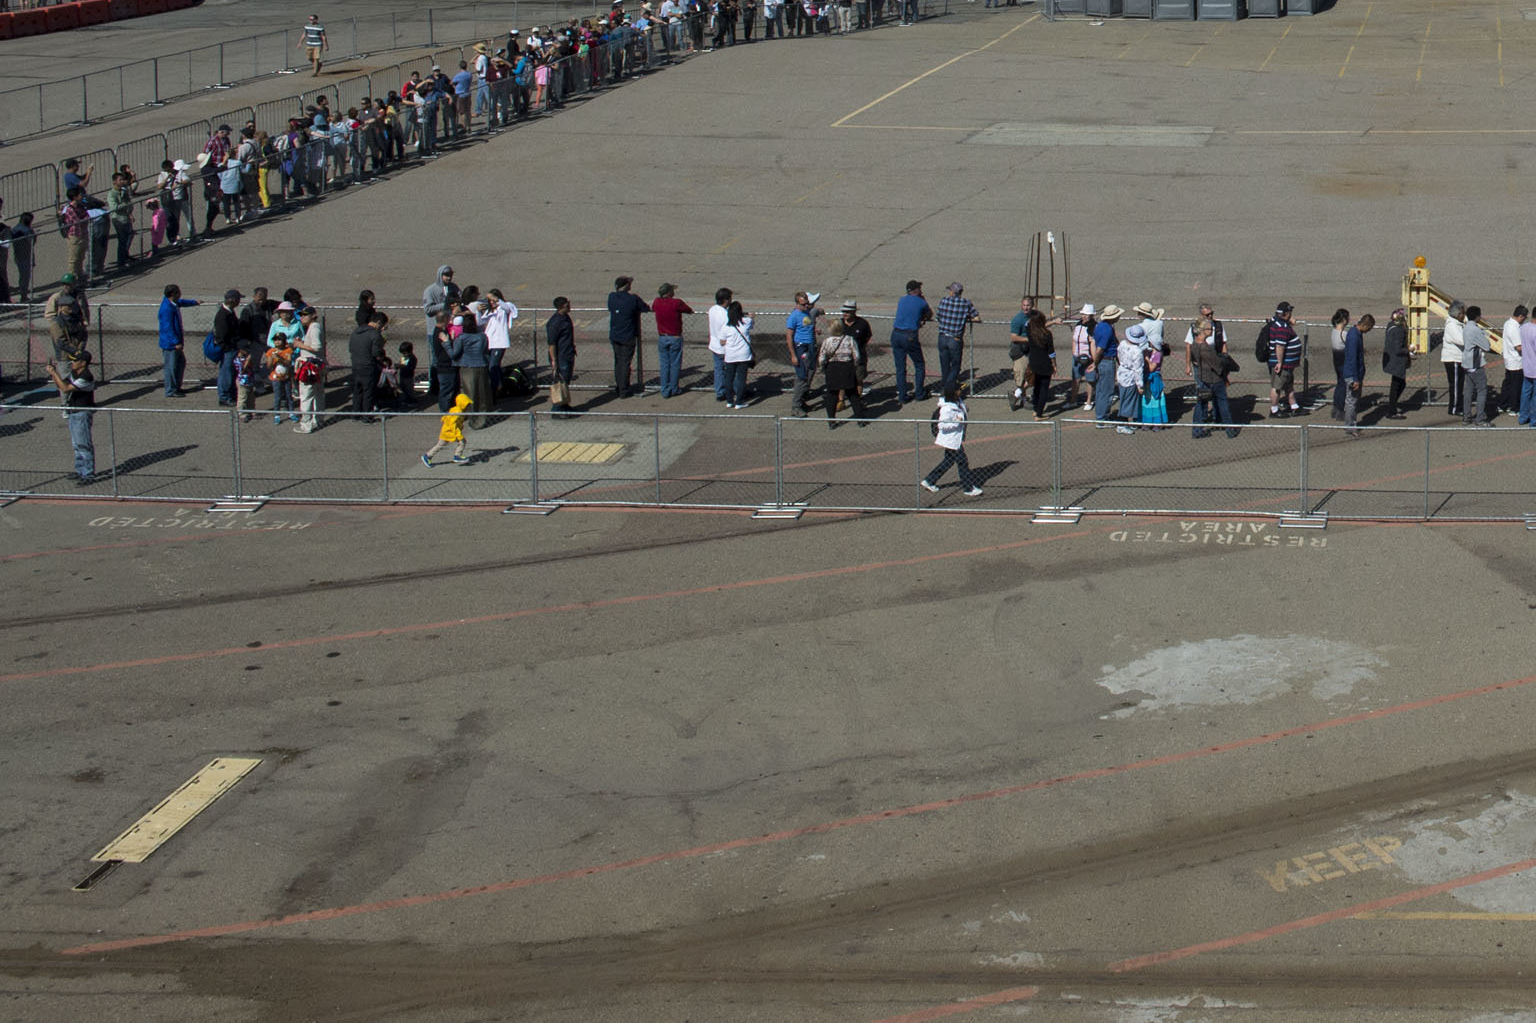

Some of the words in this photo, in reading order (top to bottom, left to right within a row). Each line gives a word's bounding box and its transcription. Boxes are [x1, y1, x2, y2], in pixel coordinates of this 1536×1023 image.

[88, 516, 312, 530] RESTRICTED
[1180, 521, 1267, 534] AREA
[1109, 530, 1328, 548] RESTRICTED
[1256, 836, 1402, 893] KEEP
